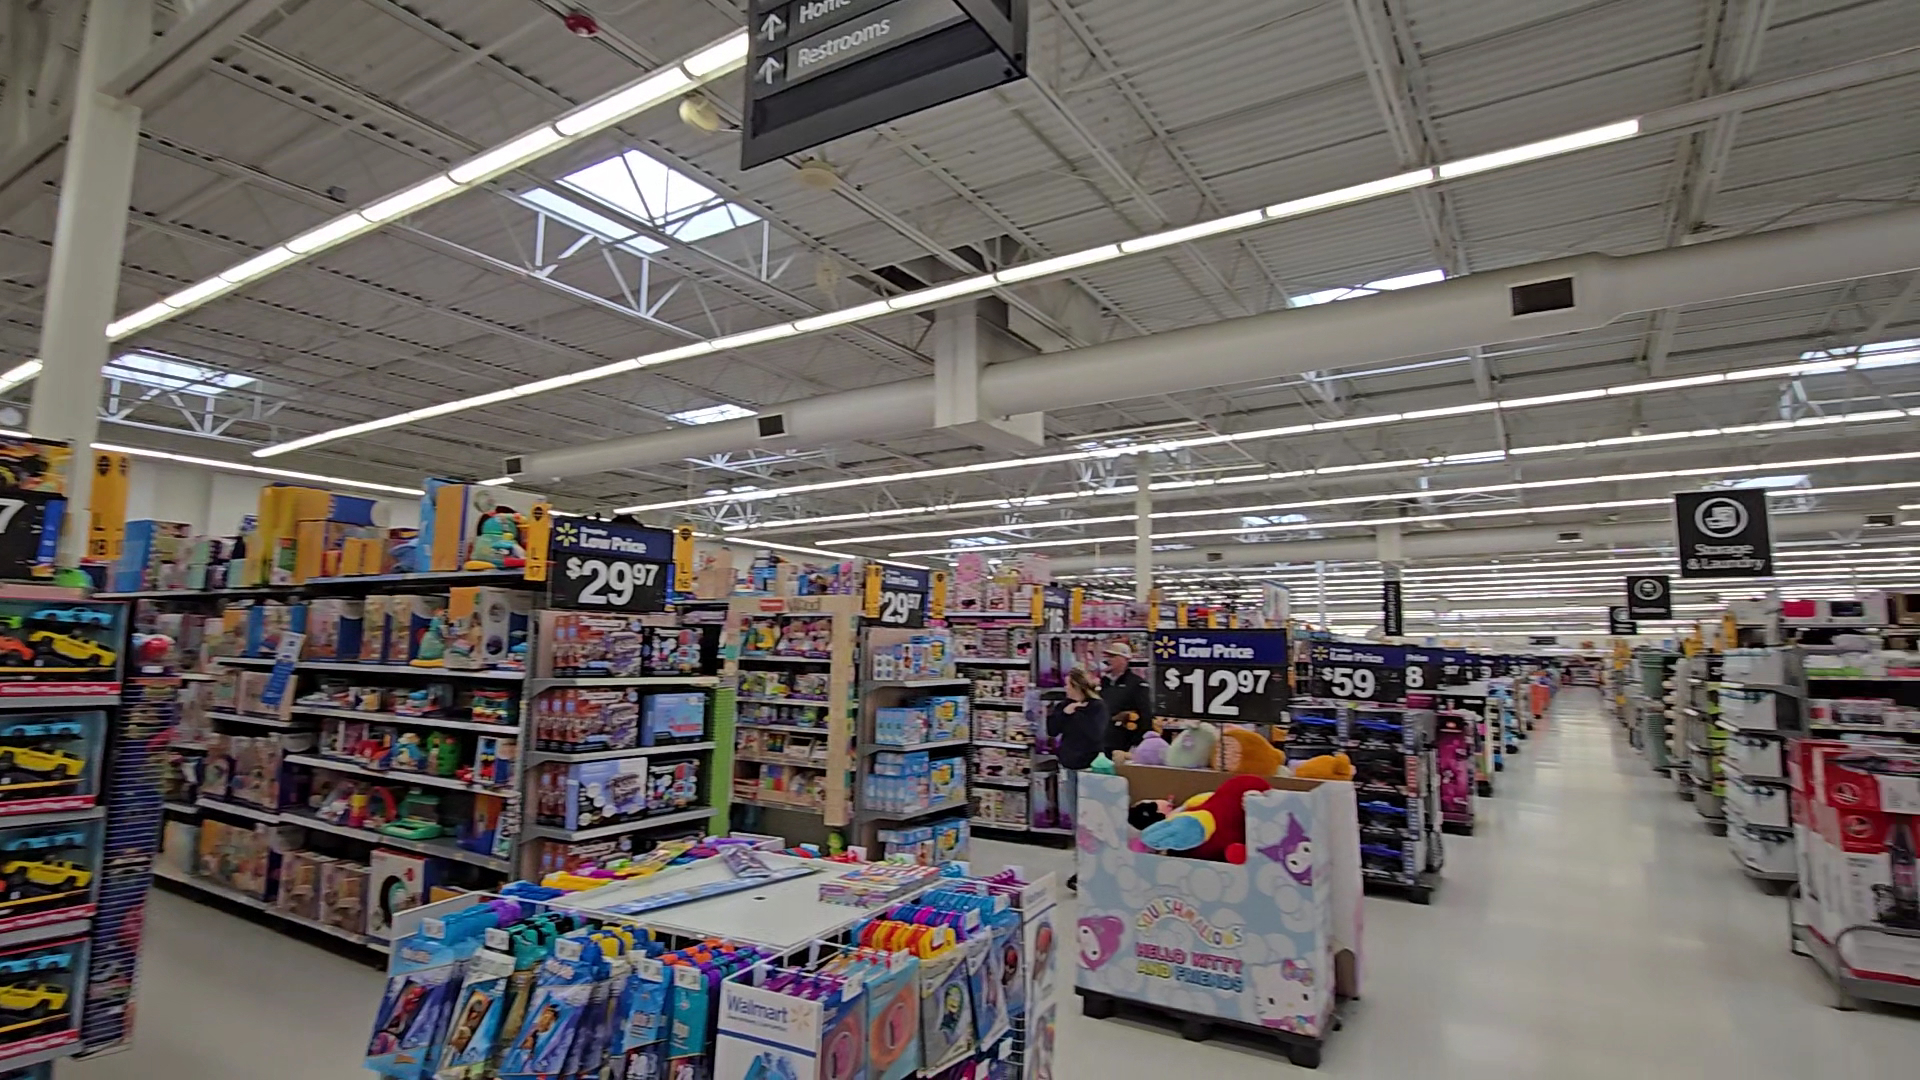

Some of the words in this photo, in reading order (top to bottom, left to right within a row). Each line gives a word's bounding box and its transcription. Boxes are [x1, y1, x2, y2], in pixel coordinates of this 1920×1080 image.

[798, 19, 890, 68] Restrooms
[580, 533, 611, 549] Low
[611, 536, 647, 554] Price
[1694, 543, 1755, 559] Storage
[1700, 558, 1766, 571] Laundry
[1178, 644, 1212, 659] Low
[1212, 643, 1255, 660] Price
[1321, 667, 1376, 698] $59
[1136, 942, 1186, 965] HELLO
[1191, 952, 1243, 975] KITTY
[1136, 961, 1171, 979] AND
[1174, 966, 1243, 993] FRIENDS
[727, 994, 788, 1024] Walmart
